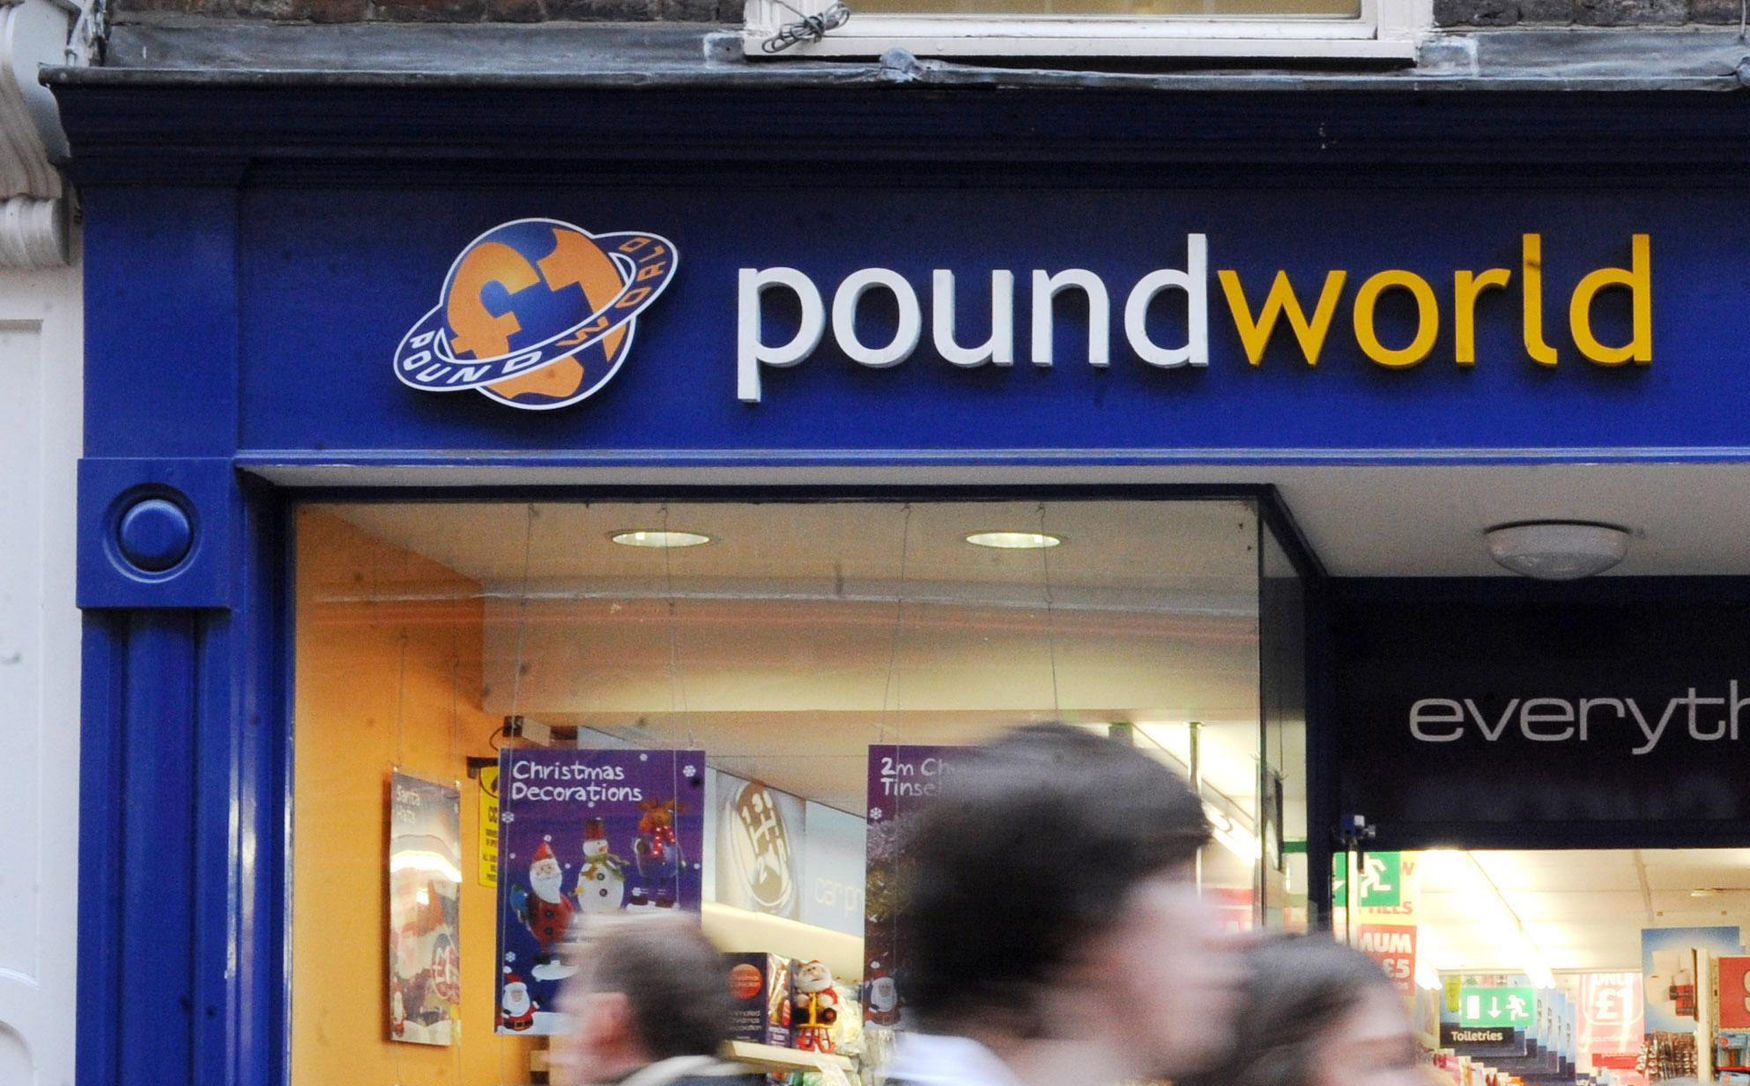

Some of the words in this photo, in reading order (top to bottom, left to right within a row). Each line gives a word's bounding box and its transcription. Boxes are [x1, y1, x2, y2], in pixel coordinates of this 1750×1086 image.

[403, 333, 543, 384] POUND
[557, 237, 667, 348] WORLD
[737, 232, 1653, 403] poundworld
[512, 760, 625, 782] Christmas
[880, 757, 914, 777] 2m
[511, 781, 643, 803] Decorations
[880, 777, 942, 797] Tinse
[1451, 1030, 1504, 1042] Toiletries
